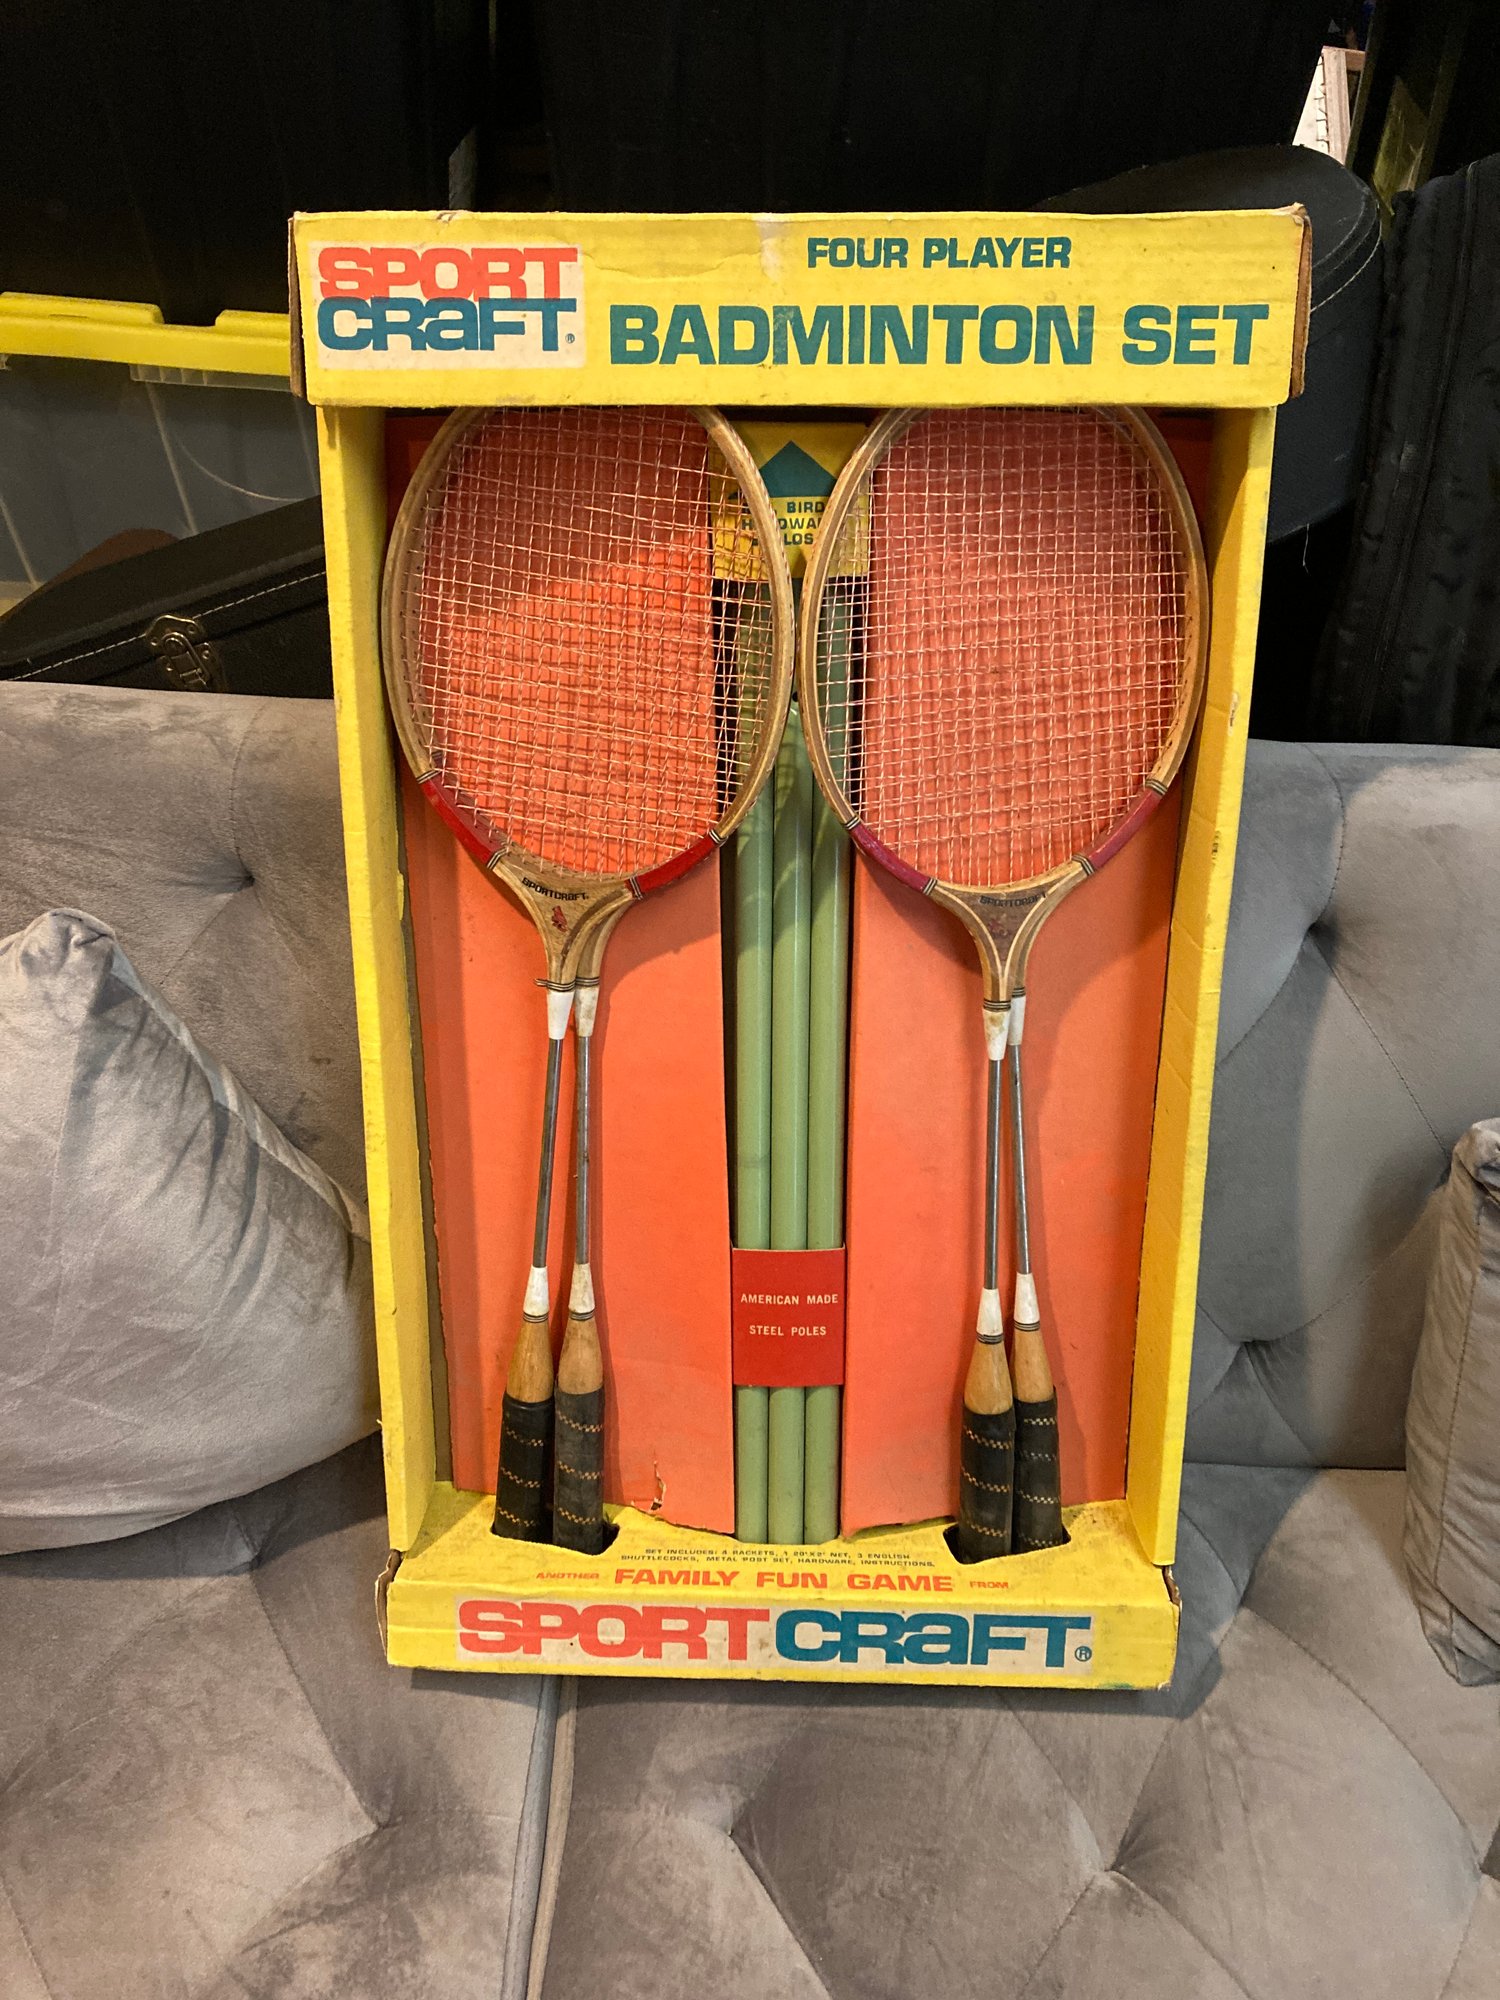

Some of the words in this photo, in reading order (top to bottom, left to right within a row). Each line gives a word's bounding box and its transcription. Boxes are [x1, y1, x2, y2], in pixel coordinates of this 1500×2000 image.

[807, 237, 908, 268] FOUR
[922, 236, 1072, 268] PLAYER
[317, 247, 578, 301] SPORT
[610, 304, 1095, 365] BADMINTON
[1122, 304, 1270, 365] SET
[787, 501, 826, 513] BIRD
[740, 1293, 799, 1305] AMERICAN
[806, 1293, 838, 1305] MADE
[749, 1325, 784, 1336] STEEL
[791, 1326, 827, 1336] POLES
[621, 1554, 700, 1563] SHUTTLECOCKS,
[772, 1557, 793, 1565] SET,
[797, 1558, 856, 1566] HARDWARE,
[536, 1571, 600, 1580] ANOTHER
[615, 1568, 740, 1587] FAMILY
[756, 1571, 828, 1589] FUN
[846, 1573, 953, 1592] GAME
[969, 1580, 1009, 1590] FROM
